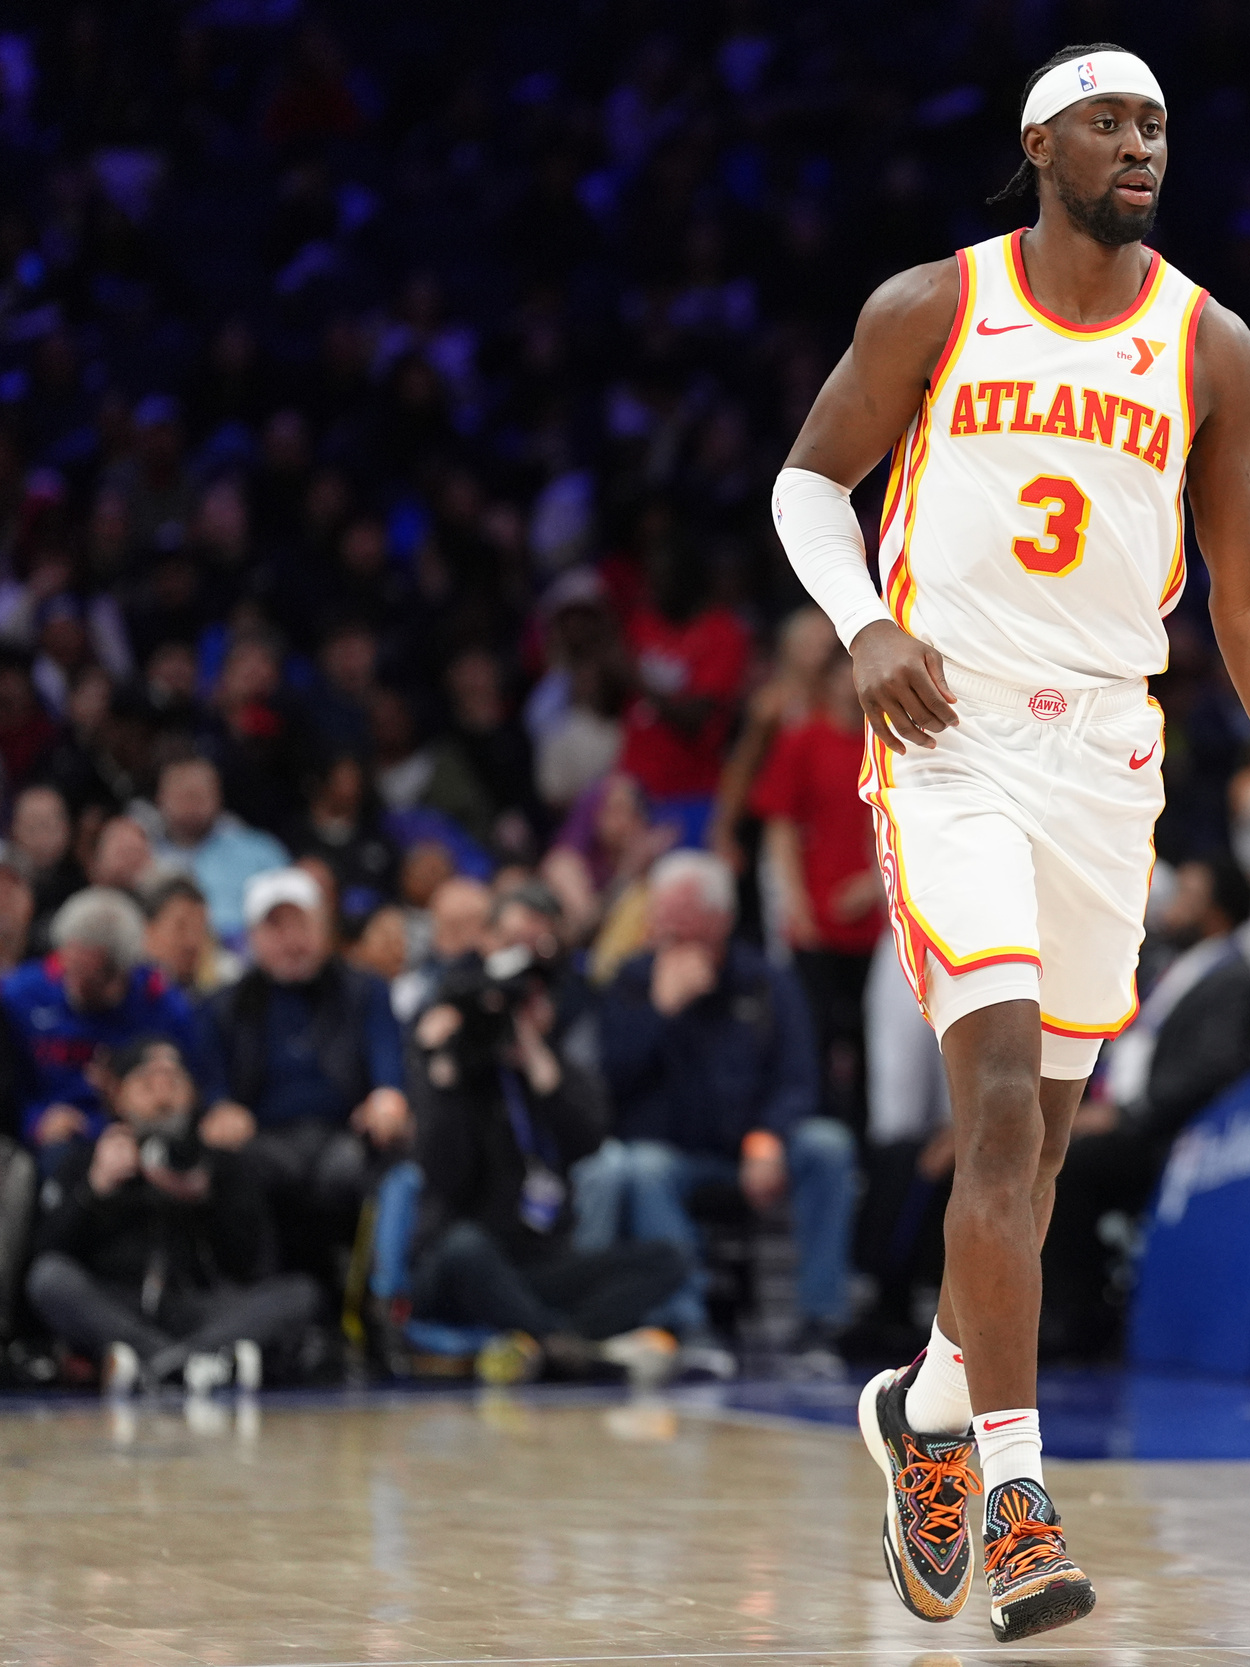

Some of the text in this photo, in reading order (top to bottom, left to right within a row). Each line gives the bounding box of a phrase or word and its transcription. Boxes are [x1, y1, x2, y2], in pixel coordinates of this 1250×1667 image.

[1116, 351, 1133, 361] the
[950, 380, 1173, 475] ATLANTA
[1011, 473, 1092, 578] 3
[1027, 697, 1068, 713] HAWKS
